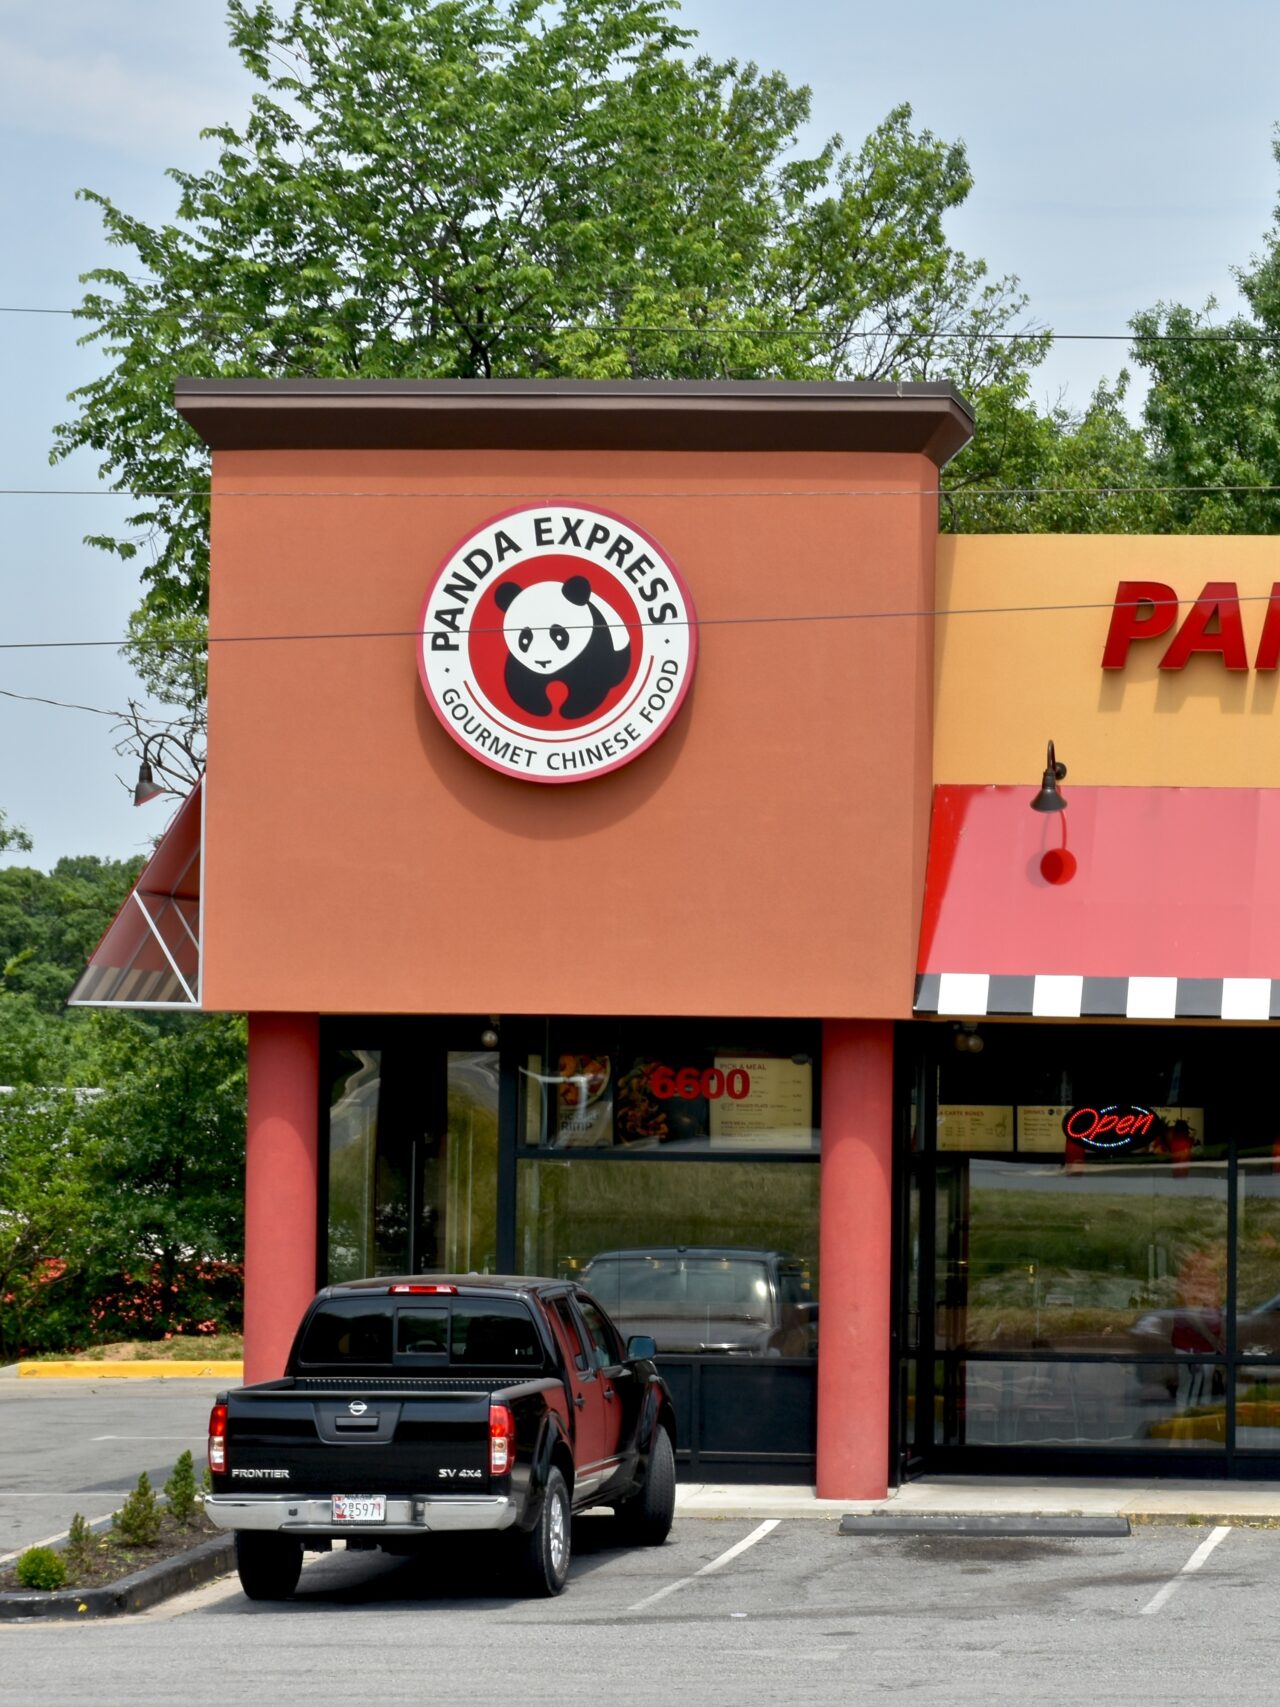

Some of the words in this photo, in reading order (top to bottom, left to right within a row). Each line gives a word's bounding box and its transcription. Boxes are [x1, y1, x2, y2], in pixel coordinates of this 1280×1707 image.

[431, 530, 522, 651] PANDA
[533, 516, 678, 624] EXPRESS
[442, 688, 537, 767] GOURMET
[546, 723, 641, 770] CHINESE
[639, 659, 679, 724] FOOD
[650, 1067, 750, 1099] 6600
[1067, 1108, 1154, 1140] Open
[232, 1469, 290, 1478] FRONTIER
[439, 1469, 456, 1477] SV
